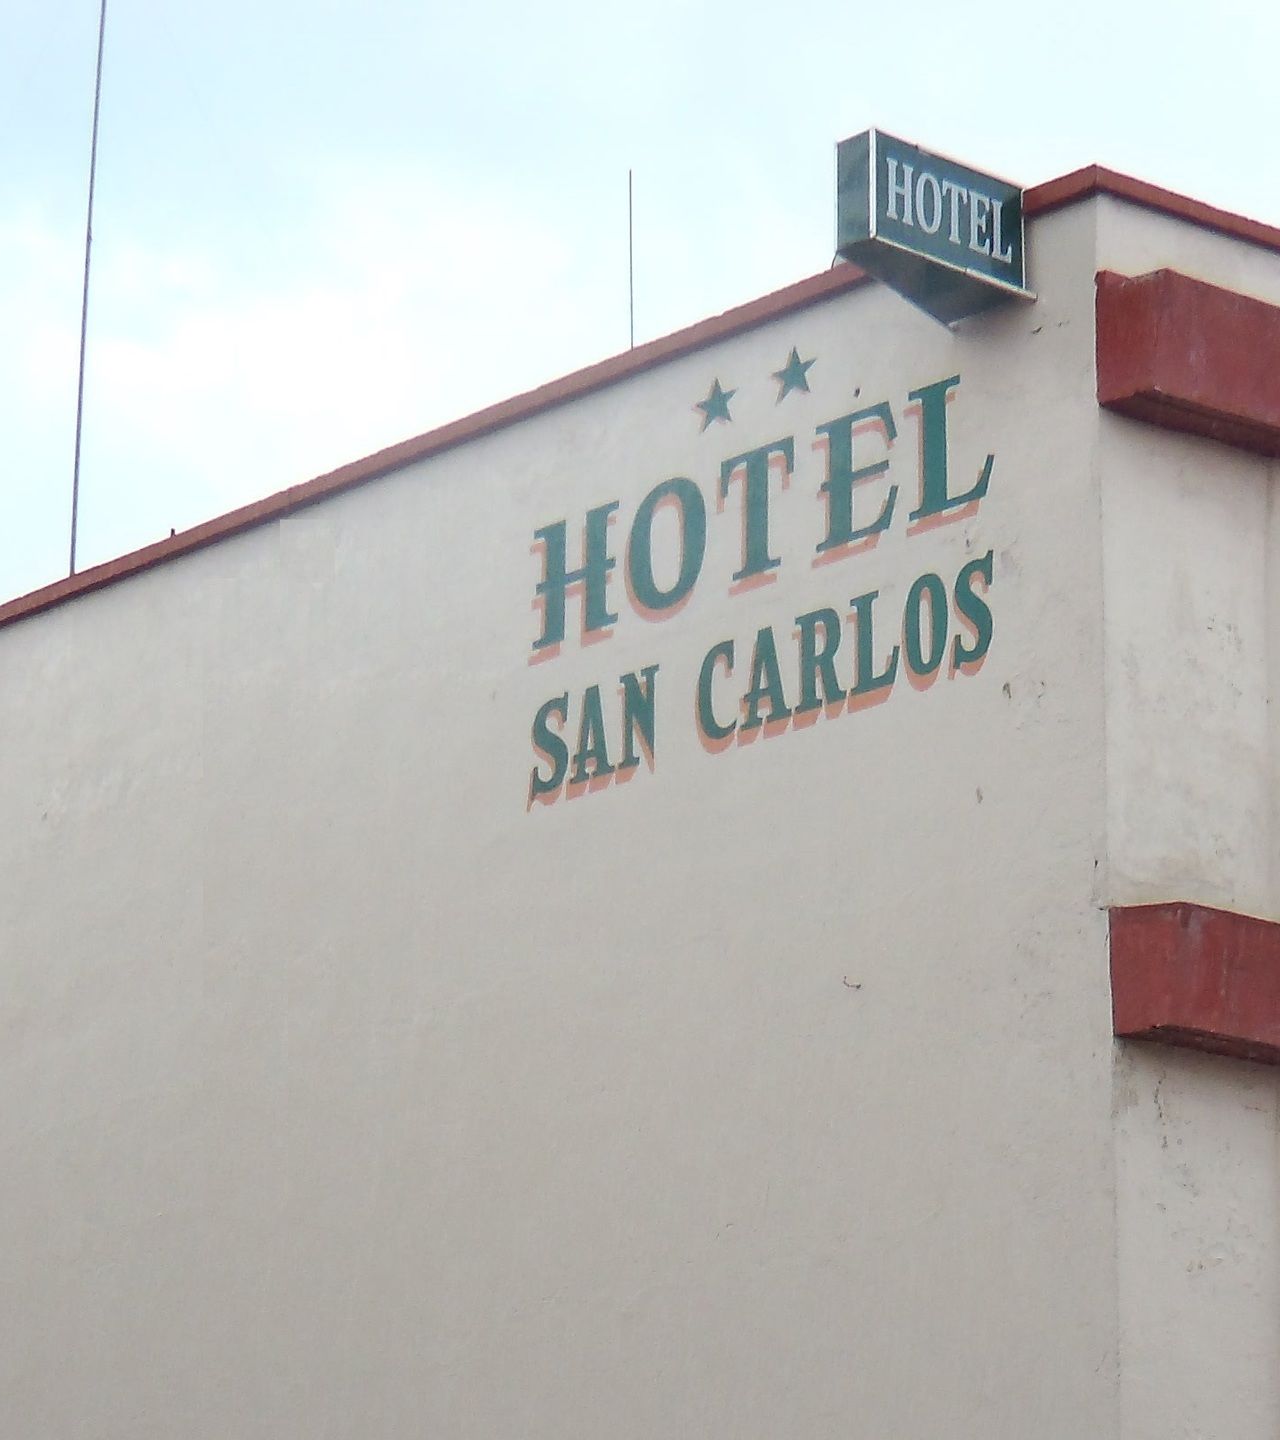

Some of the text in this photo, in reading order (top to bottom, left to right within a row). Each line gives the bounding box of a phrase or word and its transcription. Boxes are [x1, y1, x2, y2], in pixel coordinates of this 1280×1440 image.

[886, 157, 1012, 263] HOTEL
[529, 375, 995, 662] HOTEL
[526, 550, 994, 808] SAN CARLOS
